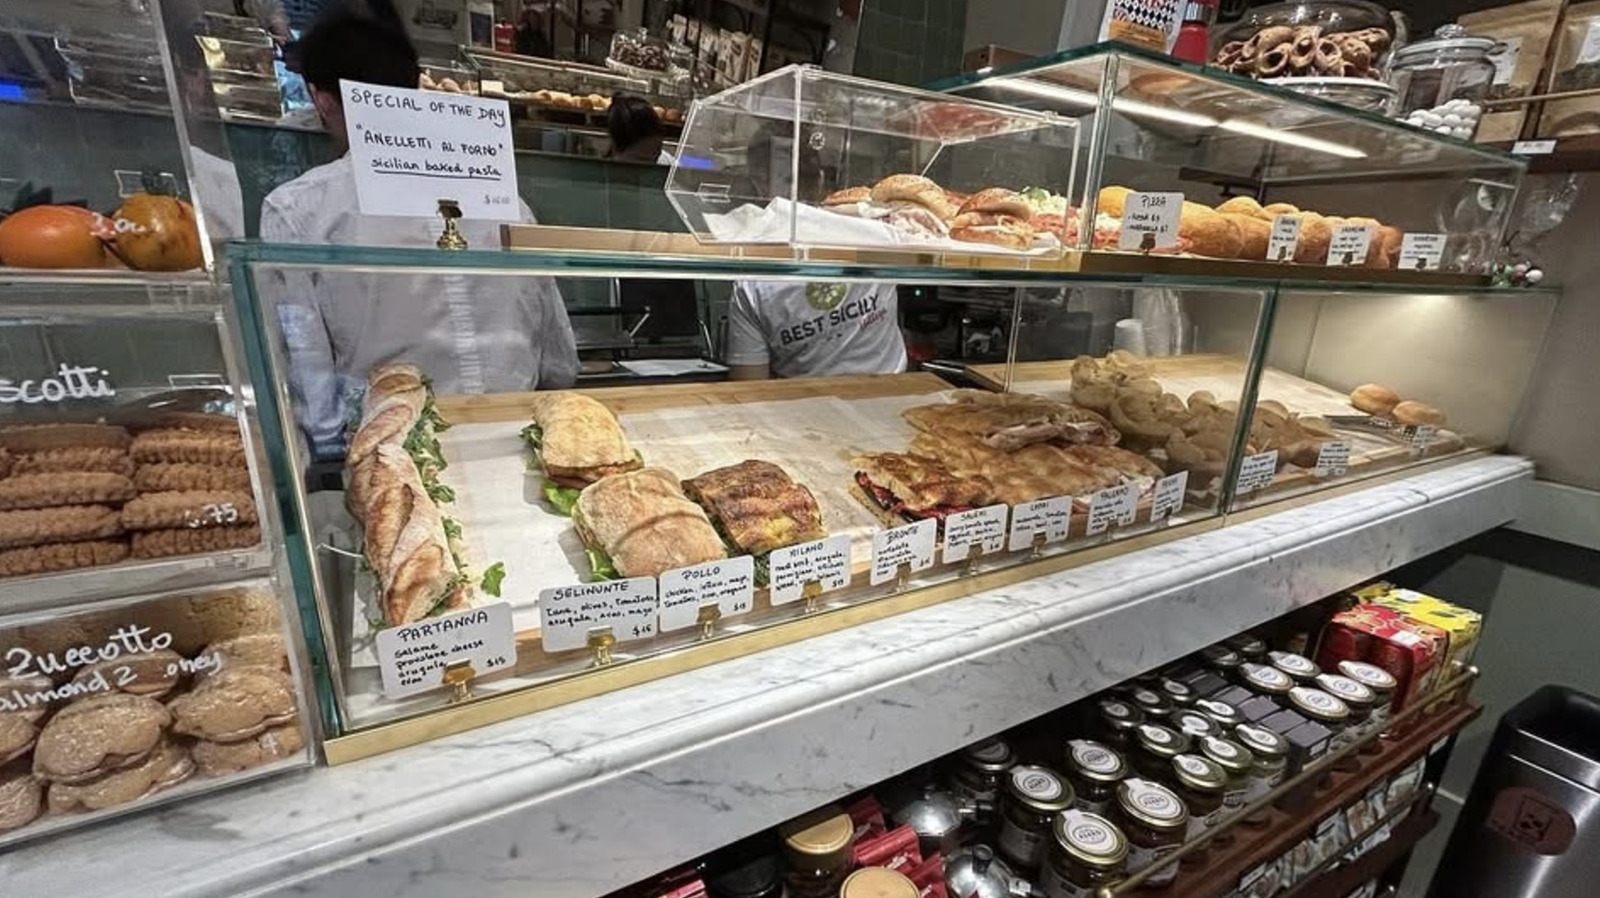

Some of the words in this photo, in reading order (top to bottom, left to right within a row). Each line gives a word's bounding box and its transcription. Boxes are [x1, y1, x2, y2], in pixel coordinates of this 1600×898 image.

[351, 88, 422, 112] SPECIAL
[430, 101, 445, 113] OF
[449, 104, 472, 116] THE
[477, 107, 505, 128] DAY
[441, 142, 455, 152] AL
[371, 157, 420, 171] sicilian
[425, 160, 464, 173] baked
[467, 165, 502, 179] pasta
[780, 315, 824, 346] BEST
[829, 293, 879, 326] SICILY
[789, 542, 824, 557] MILANO
[681, 566, 721, 580] POLLO
[553, 581, 630, 601] SELINUNTE
[397, 610, 488, 642] PARTANNA
[451, 640, 484, 653] cheese
